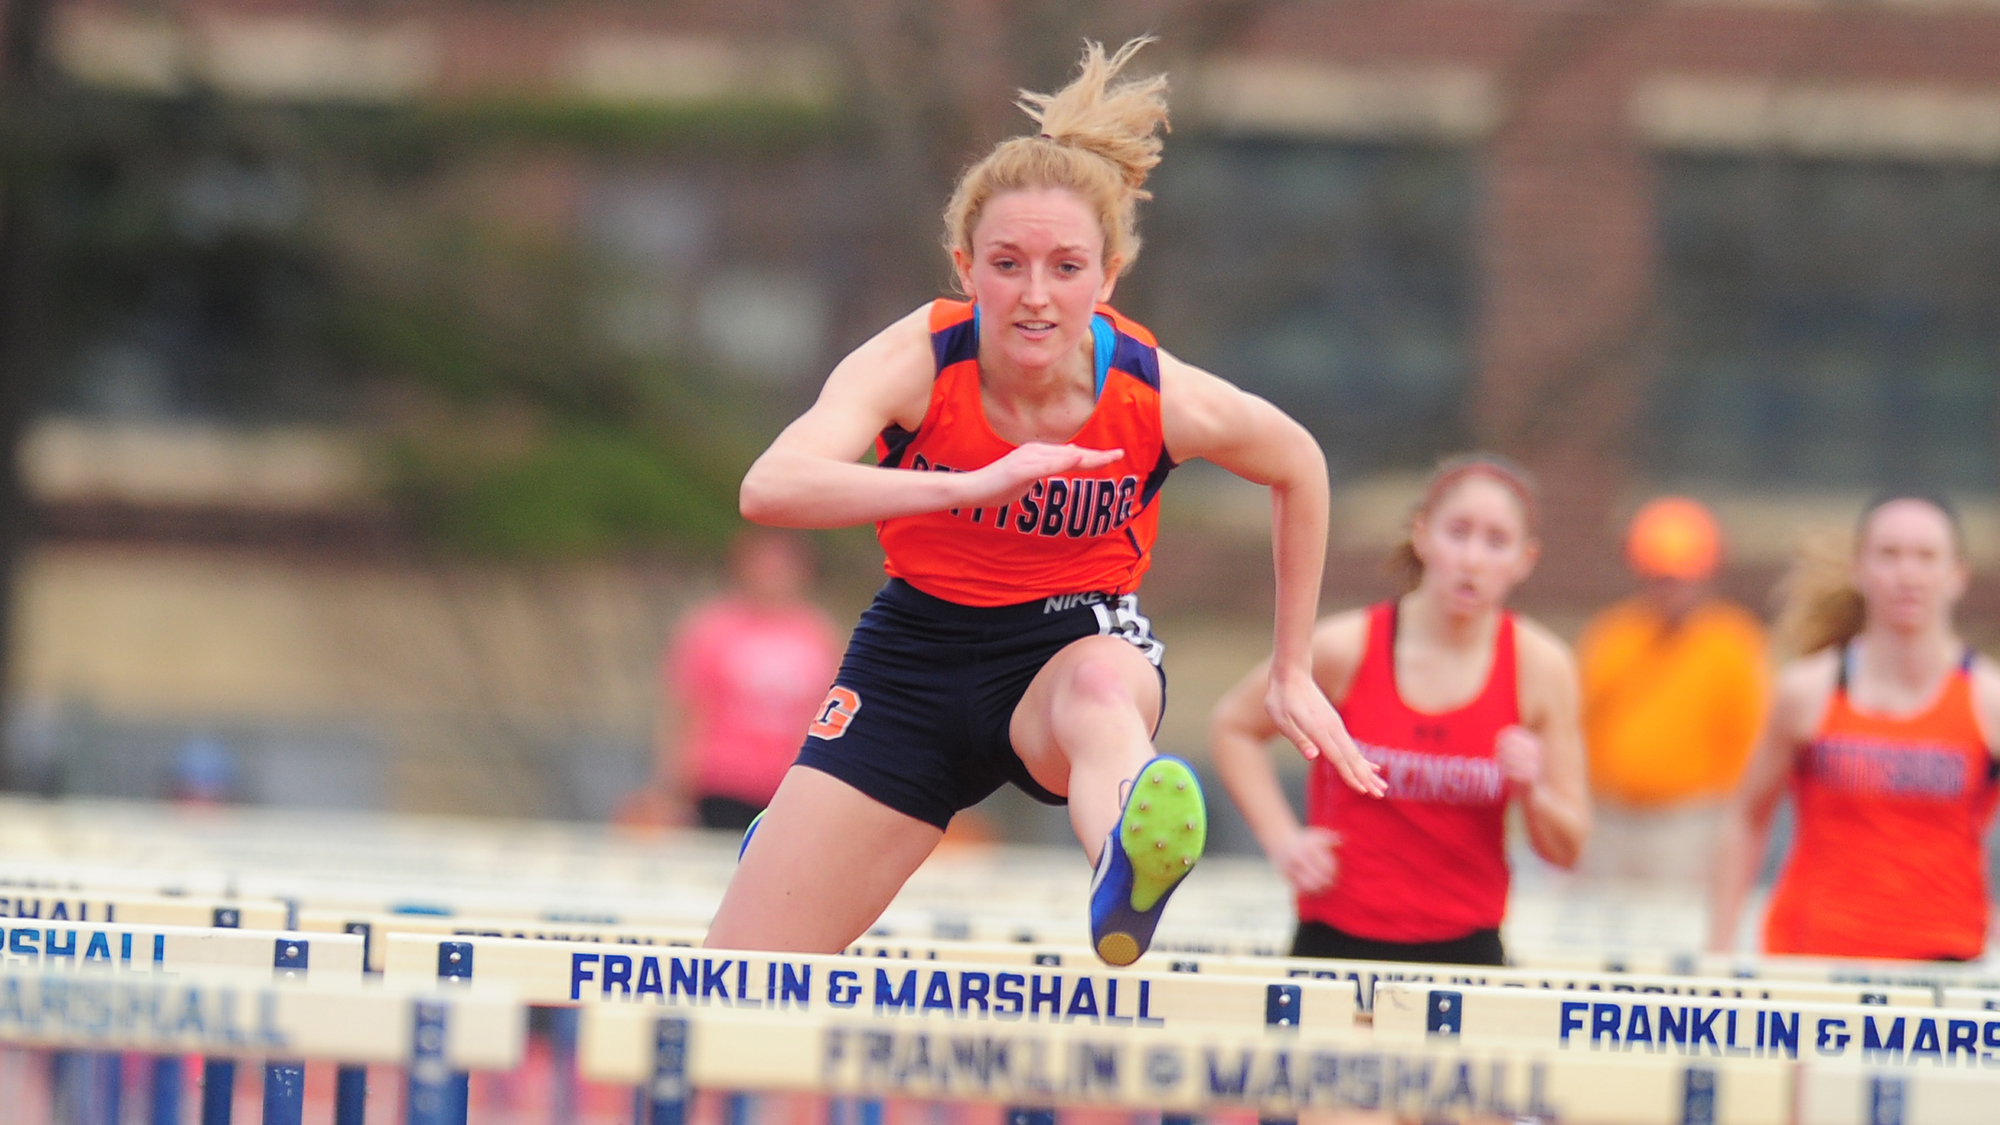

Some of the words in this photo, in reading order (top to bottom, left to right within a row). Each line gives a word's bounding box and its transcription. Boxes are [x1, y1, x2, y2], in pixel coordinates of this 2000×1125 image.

[911, 452, 1138, 538] SBURG
[1043, 591, 1101, 614] NIKE
[1350, 739, 1502, 801] KINSON
[0, 928, 180, 974] SHALL
[570, 952, 811, 1011] FRANKLIN
[826, 969, 862, 1009] &
[873, 967, 1166, 1028] MARSHALL
[1560, 1000, 1800, 1060] FRANKLIN
[1815, 1017, 1852, 1056] &
